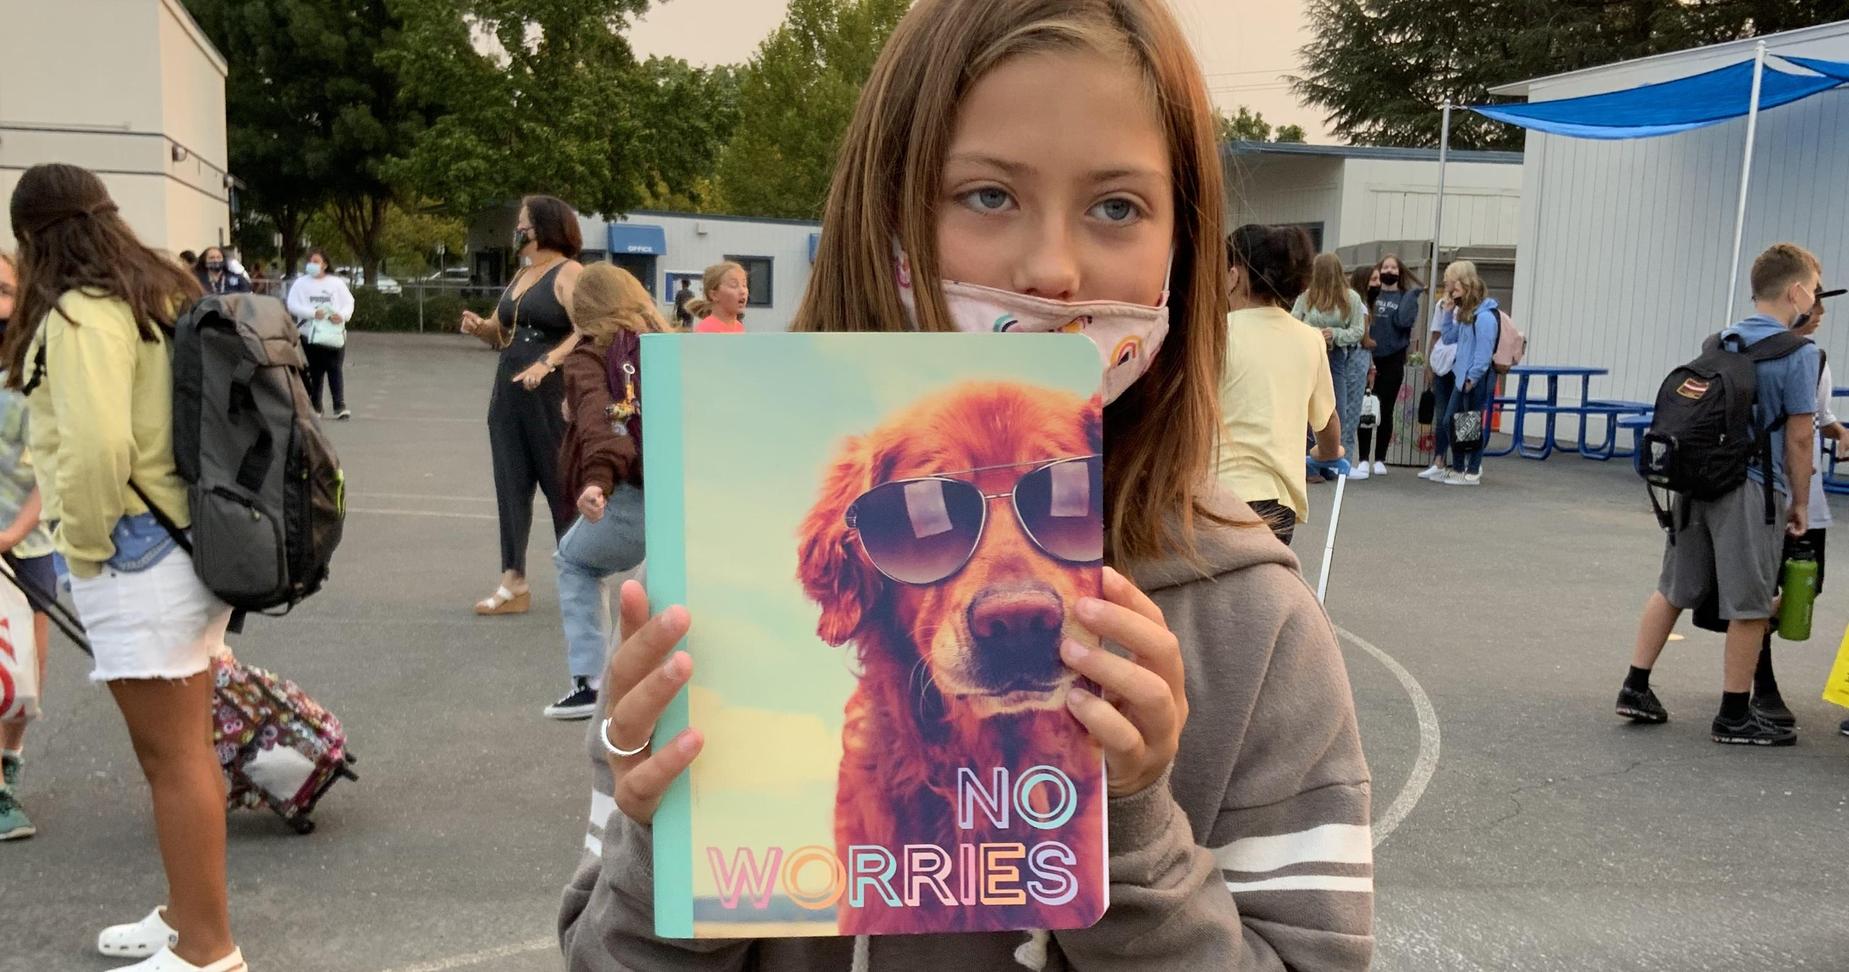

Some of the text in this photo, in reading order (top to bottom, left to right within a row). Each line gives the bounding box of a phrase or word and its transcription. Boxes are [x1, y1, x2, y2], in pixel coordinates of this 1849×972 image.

[627, 245, 653, 253] OFFICE
[957, 765, 1078, 830] NO
[706, 840, 1079, 910] WORRIES
